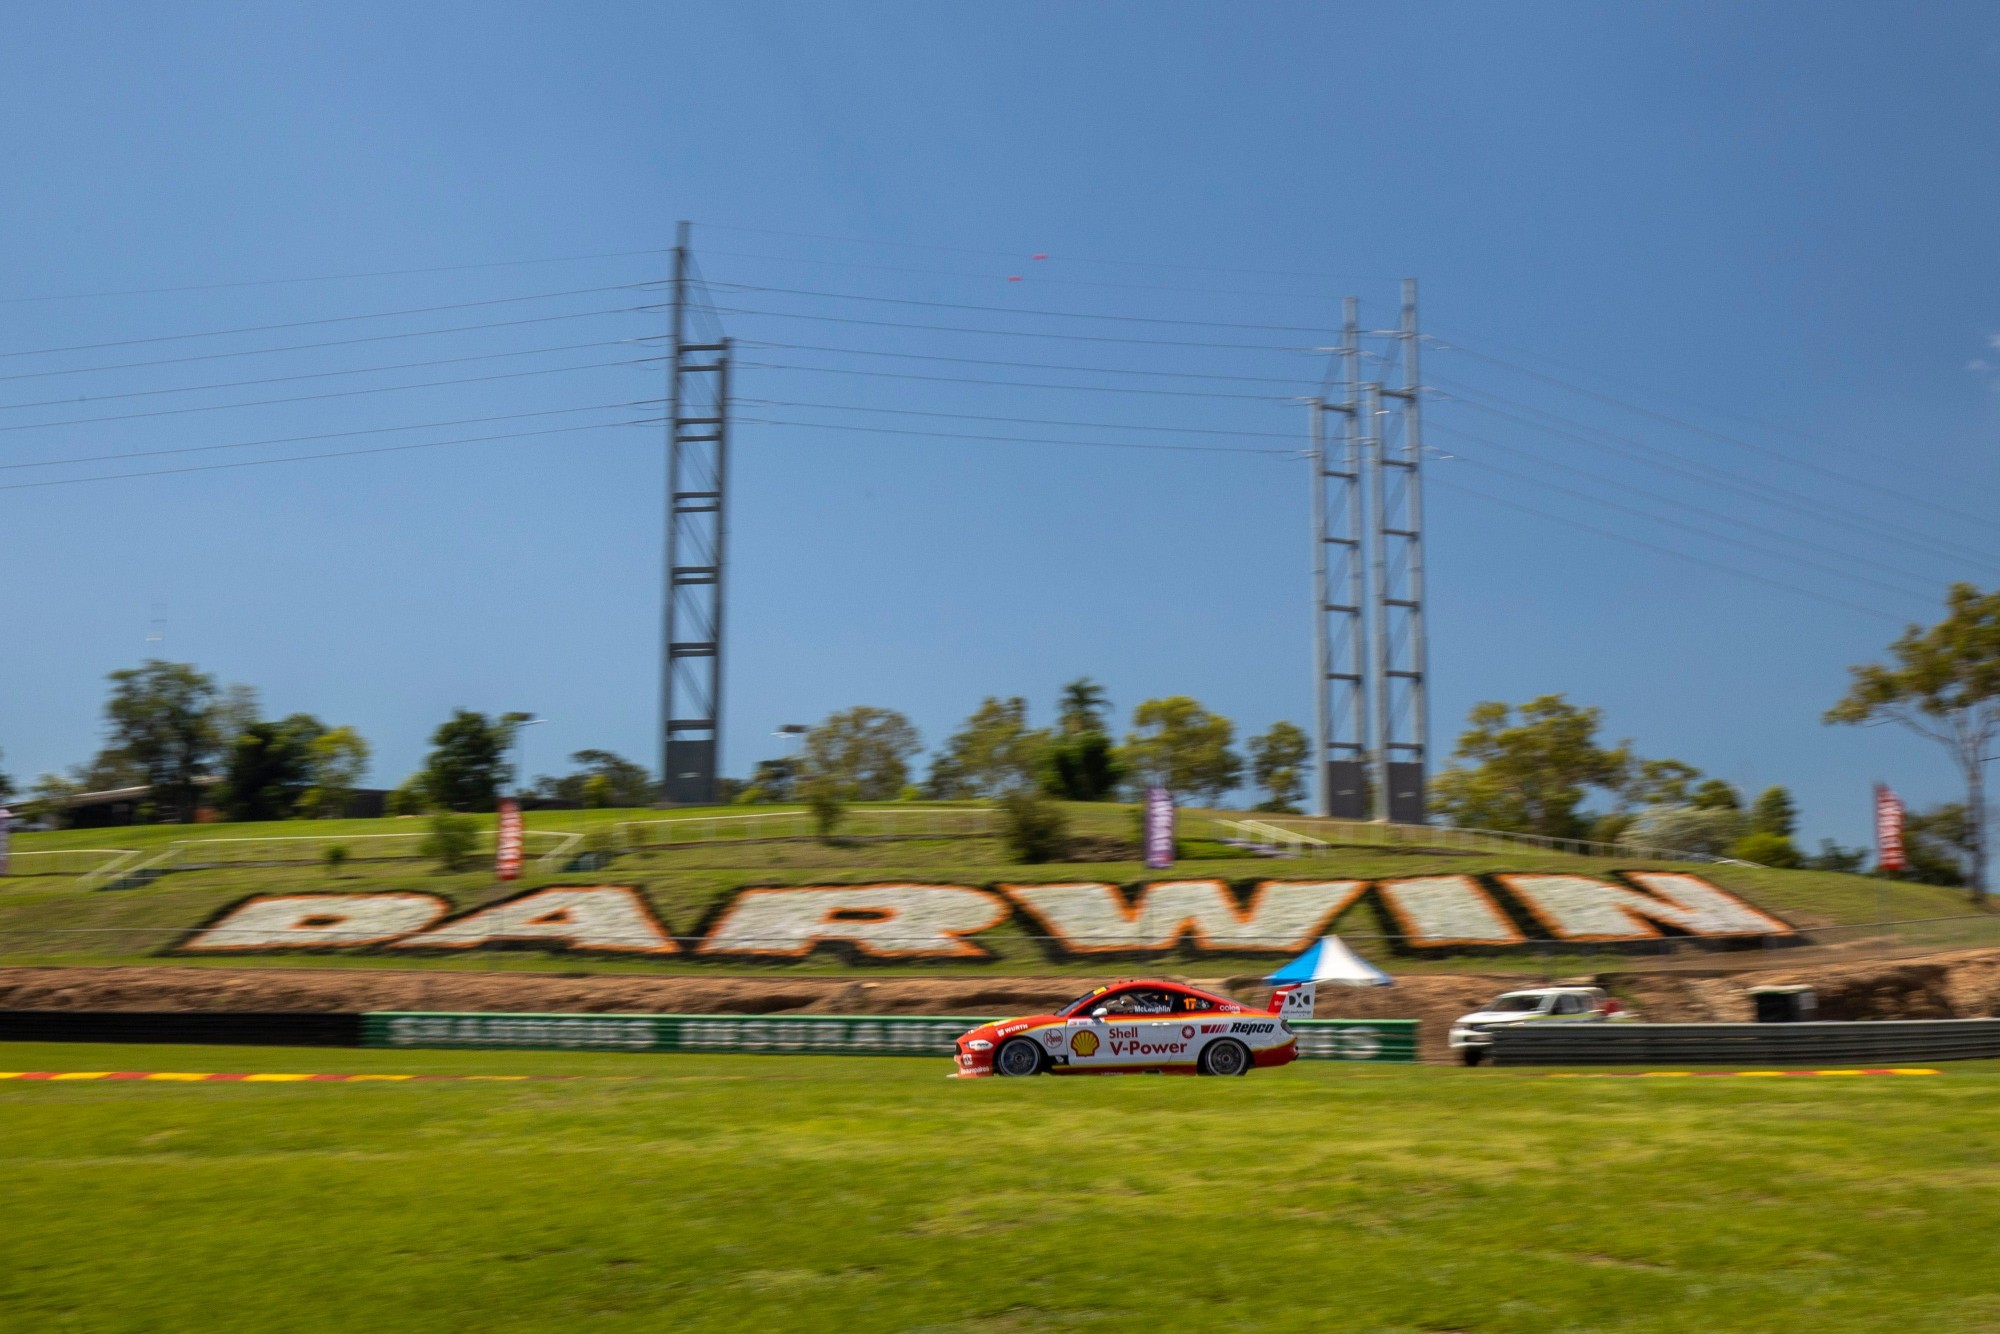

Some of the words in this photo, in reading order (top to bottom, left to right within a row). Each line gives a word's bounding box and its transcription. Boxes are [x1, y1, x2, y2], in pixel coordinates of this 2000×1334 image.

[183, 871, 1795, 957] DARWIN
[1183, 998, 1197, 1010] 17
[1109, 1026, 1138, 1039] Shell
[1230, 1022, 1275, 1035] Repco
[1109, 1040, 1188, 1056] V-Power
